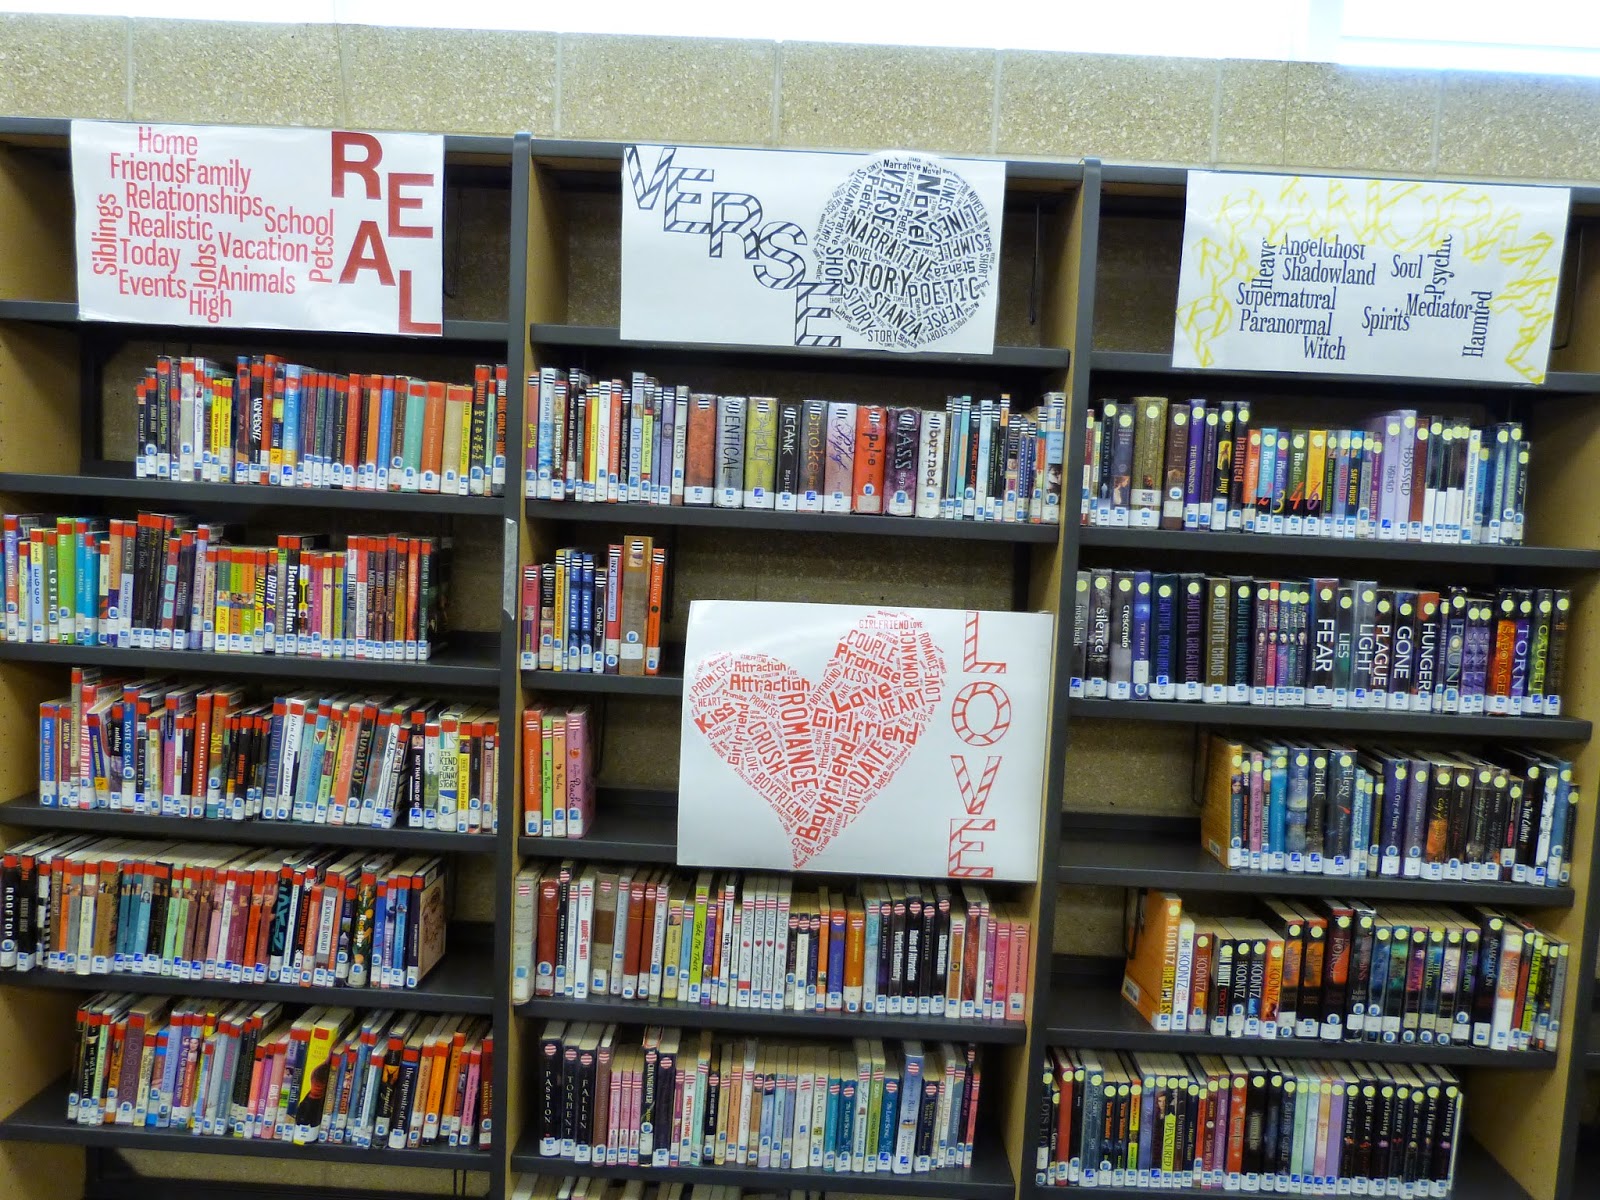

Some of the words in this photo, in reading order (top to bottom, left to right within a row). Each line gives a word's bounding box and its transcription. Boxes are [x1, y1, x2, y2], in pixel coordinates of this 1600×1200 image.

[138, 126, 198, 155] Home
[111, 153, 186, 184] Friends
[186, 157, 251, 193] Family
[884, 159, 921, 171] Narrative
[922, 167, 941, 175] Novel
[126, 182, 263, 222] Relationships
[871, 170, 907, 229] VERSE
[908, 174, 941, 247] Novel
[938, 178, 958, 212] LINES
[967, 191, 984, 215] NOVEL
[92, 194, 122, 275] Siblings
[128, 211, 212, 241] Realistic
[265, 206, 334, 237] School
[928, 203, 978, 242] LINES
[119, 238, 180, 269] Today
[219, 232, 308, 263] Vacation
[309, 236, 333, 283] Pets
[845, 216, 940, 281] NARRATIVE
[846, 244, 873, 261] NOVEL
[935, 234, 984, 261] SIMPLE
[118, 269, 187, 298] Events
[191, 244, 216, 293] Jobs
[218, 265, 295, 294] Animals
[844, 259, 913, 296] STORY
[1282, 258, 1376, 286] Shadowland
[1391, 254, 1423, 279] Soul
[189, 290, 232, 323] High
[843, 287, 876, 332] STORY
[907, 277, 979, 308] POETIC
[1236, 283, 1337, 313] Supernatural
[1405, 293, 1472, 320] Mediator
[869, 292, 923, 341] STANZA
[923, 303, 964, 331] VERSE
[1239, 309, 1332, 337] Paranormal
[1362, 306, 1410, 336] Spirits
[1462, 291, 1492, 358] Haunted
[868, 330, 898, 342] STORY
[1303, 336, 1346, 360] Witch
[676, 424, 685, 459] WITNESS
[927, 429, 942, 488] burned
[1233, 436, 1246, 482] haunted
[1188, 459, 1197, 494] WARNINGS
[1348, 486, 1357, 506] HOUSE
[266, 575, 277, 602] DRIFT
[286, 565, 298, 632] Borderline
[859, 620, 909, 630] GIRLFRIEND
[1094, 607, 1108, 653] silence
[1122, 605, 1130, 648] crescendo
[847, 629, 899, 663] COUPLE
[900, 630, 919, 688] ROMANCE
[918, 632, 939, 671] ROMANCE
[1210, 645, 1225, 676] CHAOS
[1315, 619, 1335, 672] FEAR
[1337, 633, 1350, 659] LIES
[1357, 623, 1375, 675] LIGHT
[1371, 624, 1391, 686] PLAGUE
[1393, 625, 1412, 679] GONE
[1418, 623, 1436, 696] HUNGER
[1511, 624, 1530, 697] TORN
[691, 662, 731, 696] PROMISE
[735, 661, 786, 673] Attraction
[834, 643, 901, 684] Promise
[843, 666, 870, 684] KISS
[730, 674, 810, 692] Attraction
[809, 668, 840, 706] BOYFRIEND
[830, 682, 892, 713] Love
[925, 671, 941, 703] LOVE
[694, 702, 736, 734] Kiss
[698, 697, 721, 707] HEART
[749, 694, 779, 718] PROMISE
[878, 688, 926, 720] HEART
[124, 720, 132, 741] TASTE
[727, 703, 749, 766] Girlfriend
[778, 693, 819, 793] ROMANCE
[812, 707, 919, 745] Girlfriend
[124, 742, 132, 753] OF
[747, 722, 788, 778] CRUSH
[948, 611, 1011, 878] LOVE
[847, 740, 893, 789] DATE
[753, 772, 809, 823] BOYFRIEND
[795, 737, 857, 841] Boyfriend
[1315, 770, 1326, 795] Tidal
[4, 887, 14, 937] ROOFTOP
[1164, 925, 1177, 965] KOONTZ
[1178, 954, 1191, 988] KOONTZ
[1194, 957, 1208, 992] KOONTZ
[1234, 963, 1247, 999] KOONTZ
[1249, 963, 1263, 998] KOONTZ
[1267, 965, 1282, 1004] KOONTZ
[544, 1071, 553, 1123] PASSION
[566, 1076, 574, 1136] TORMENT
[579, 1079, 589, 1129] FALLEN
[1164, 1121, 1175, 1167] DEVOURED
